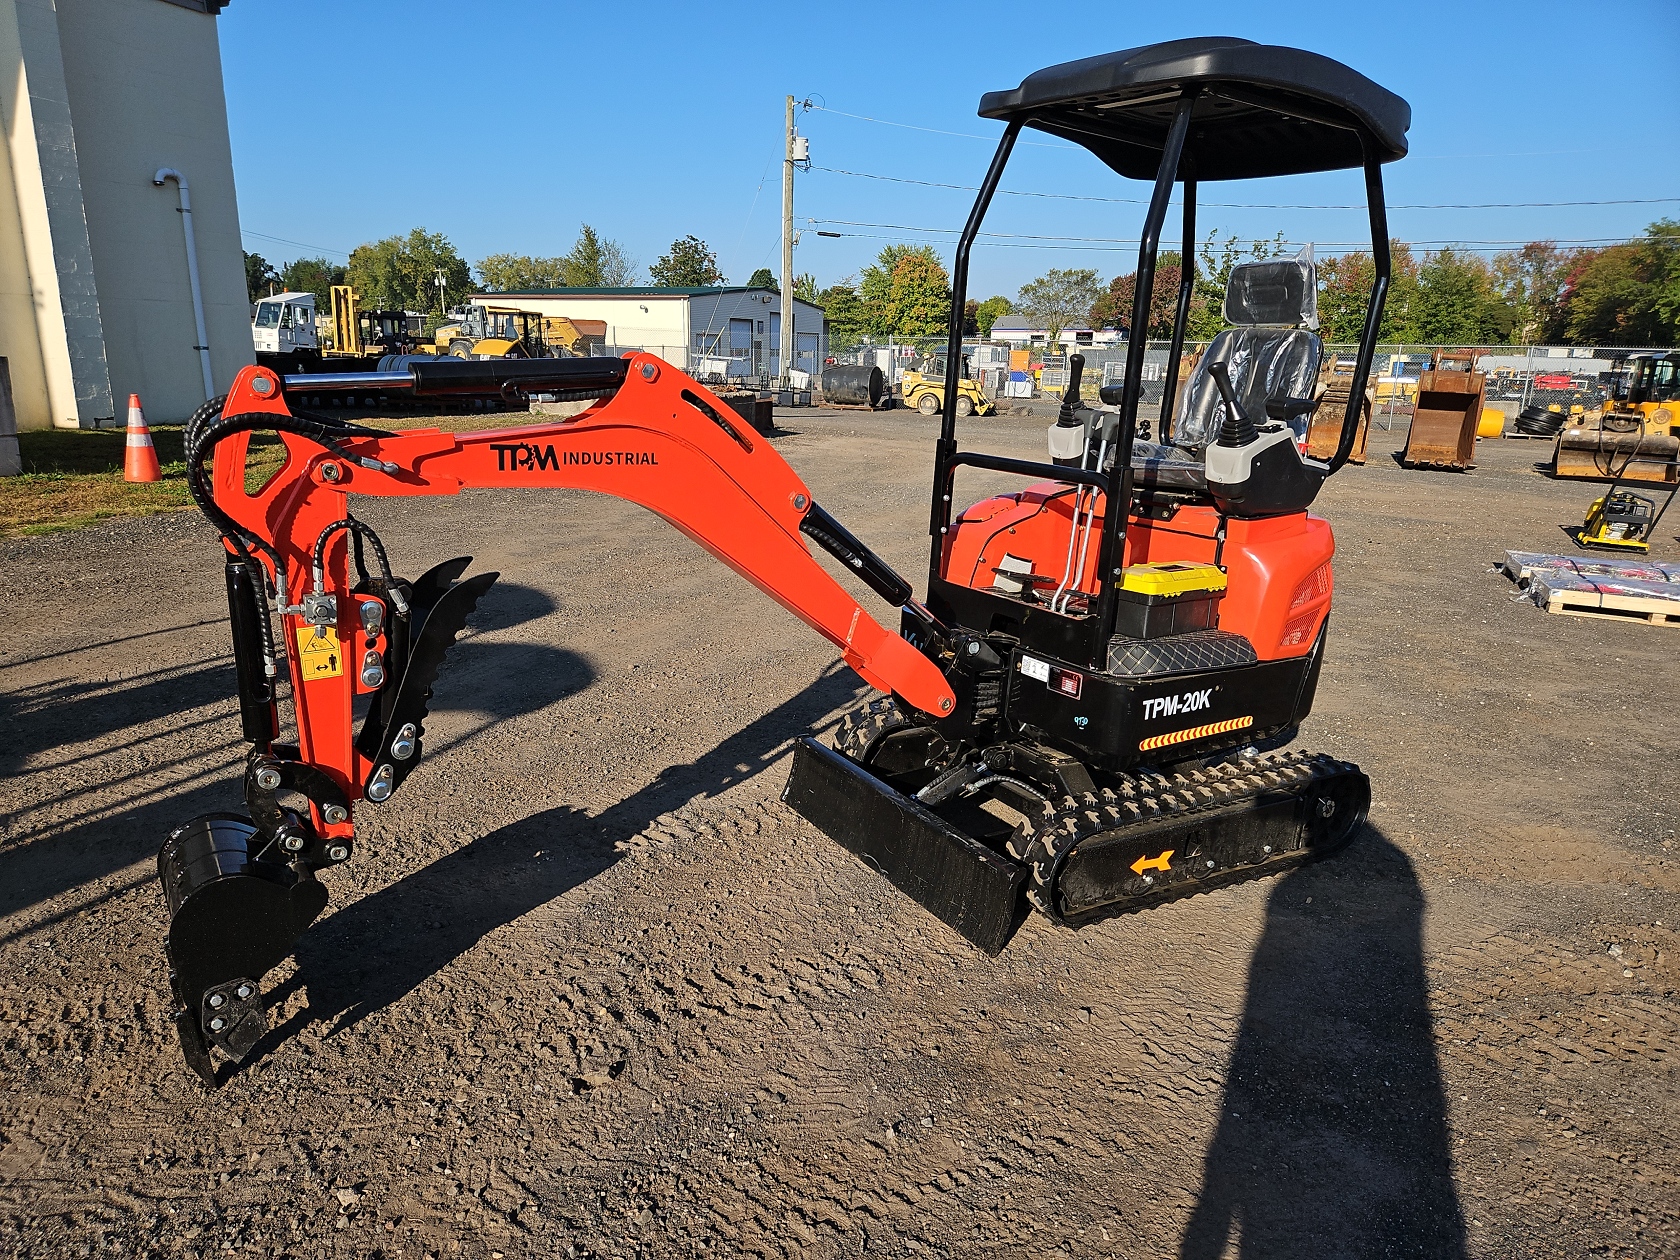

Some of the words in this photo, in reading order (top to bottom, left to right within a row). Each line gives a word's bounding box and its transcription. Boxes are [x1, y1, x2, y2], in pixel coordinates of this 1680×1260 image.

[490, 442, 560, 471] TPM
[563, 452, 658, 465] INDUSTRIAL
[1143, 688, 1213, 720] TPM-20K
